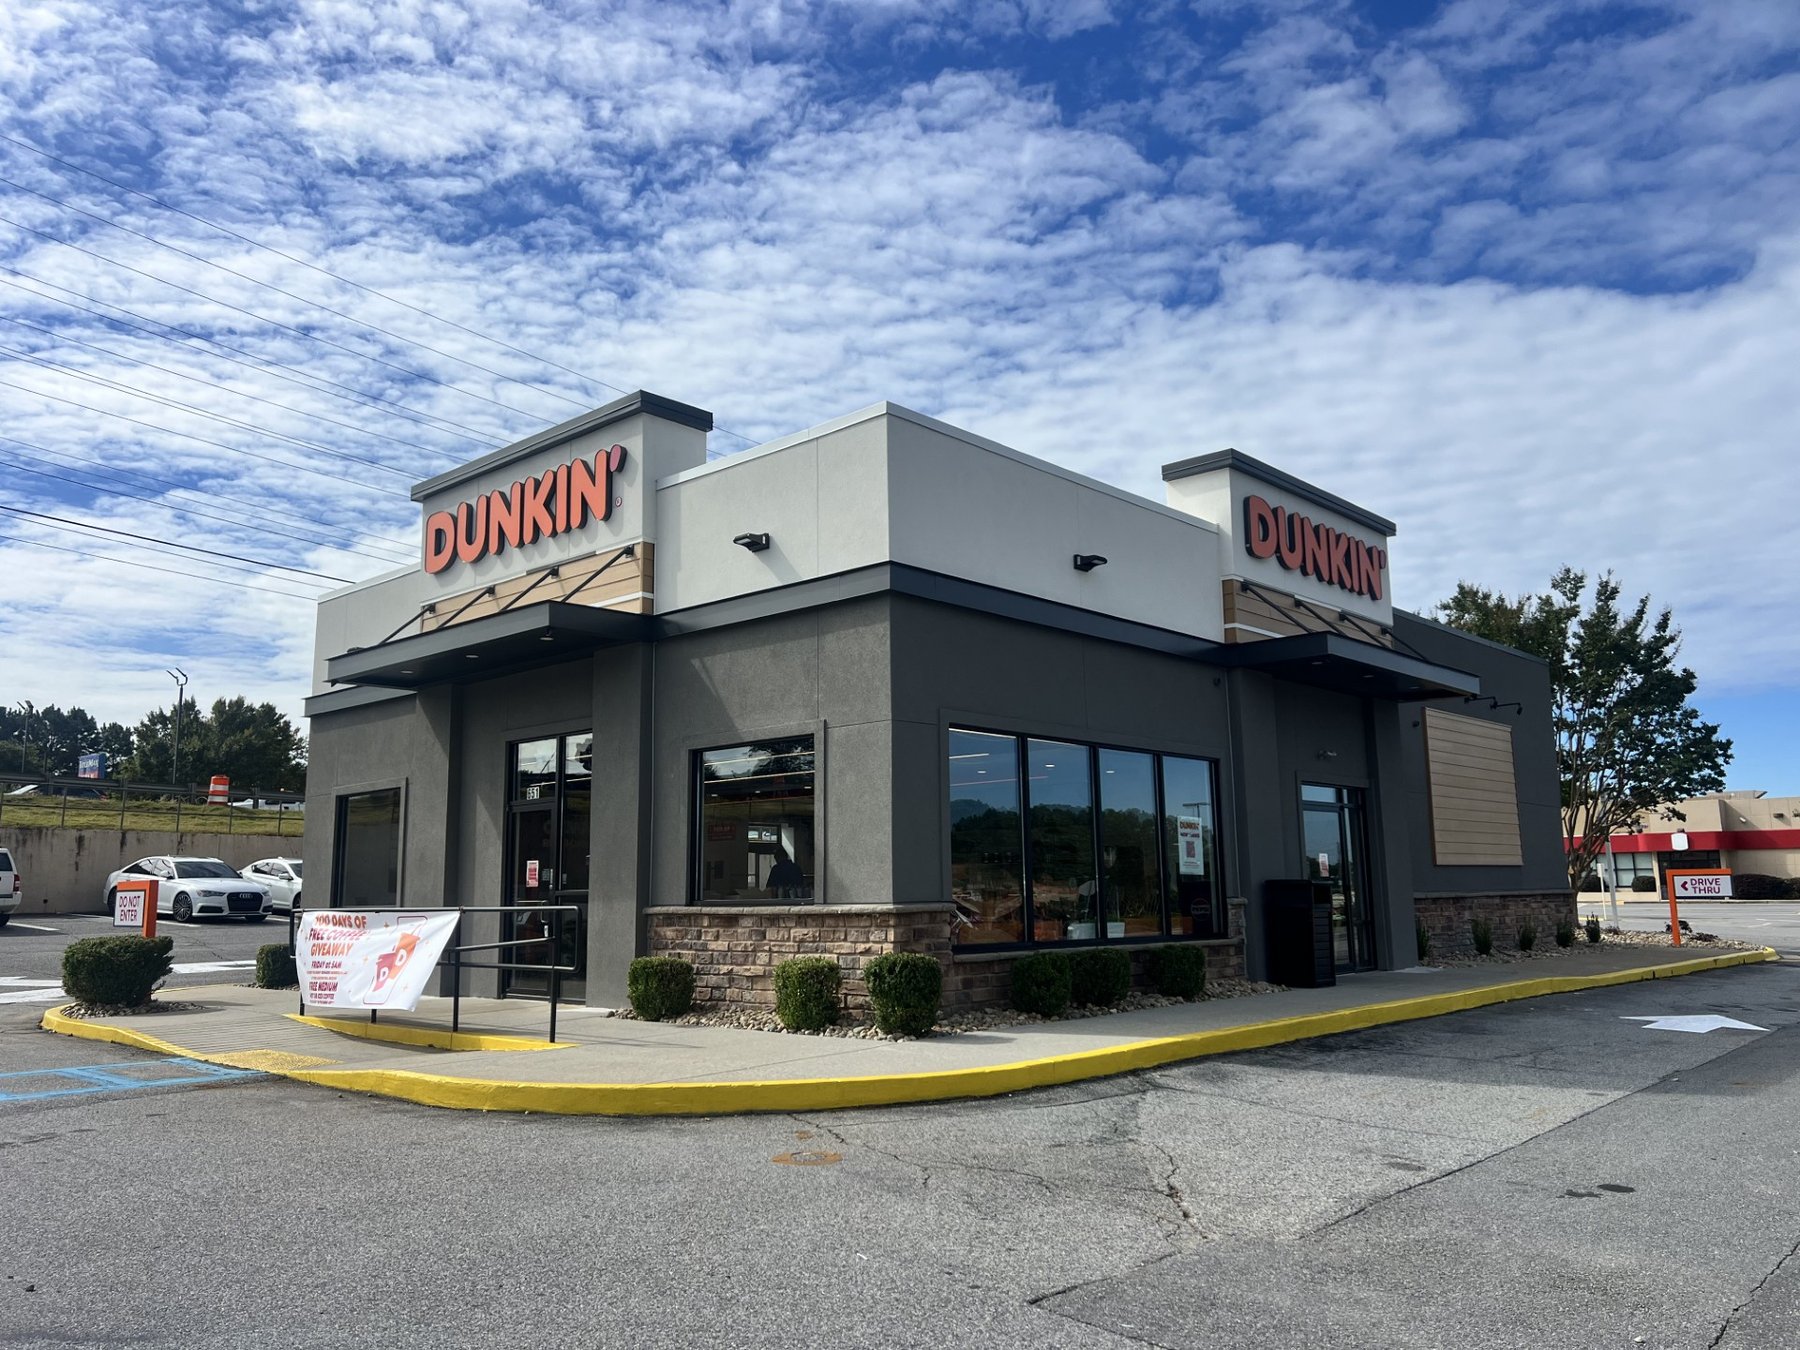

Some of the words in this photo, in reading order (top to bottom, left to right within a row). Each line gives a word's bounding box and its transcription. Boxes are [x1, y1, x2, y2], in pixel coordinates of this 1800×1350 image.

[424, 444, 627, 574] DUNKIN'
[1244, 495, 1387, 600] DUNKIN'
[1690, 878, 1720, 886] DRIVE
[1692, 886, 1720, 894] THRU
[119, 896, 128, 908] DO
[128, 896, 141, 908] NOT
[120, 909, 137, 921] ENTER
[315, 914, 330, 926] 100
[332, 914, 353, 928] DAYS
[354, 915, 367, 929] OF
[311, 943, 353, 956] GIVEAWAY
